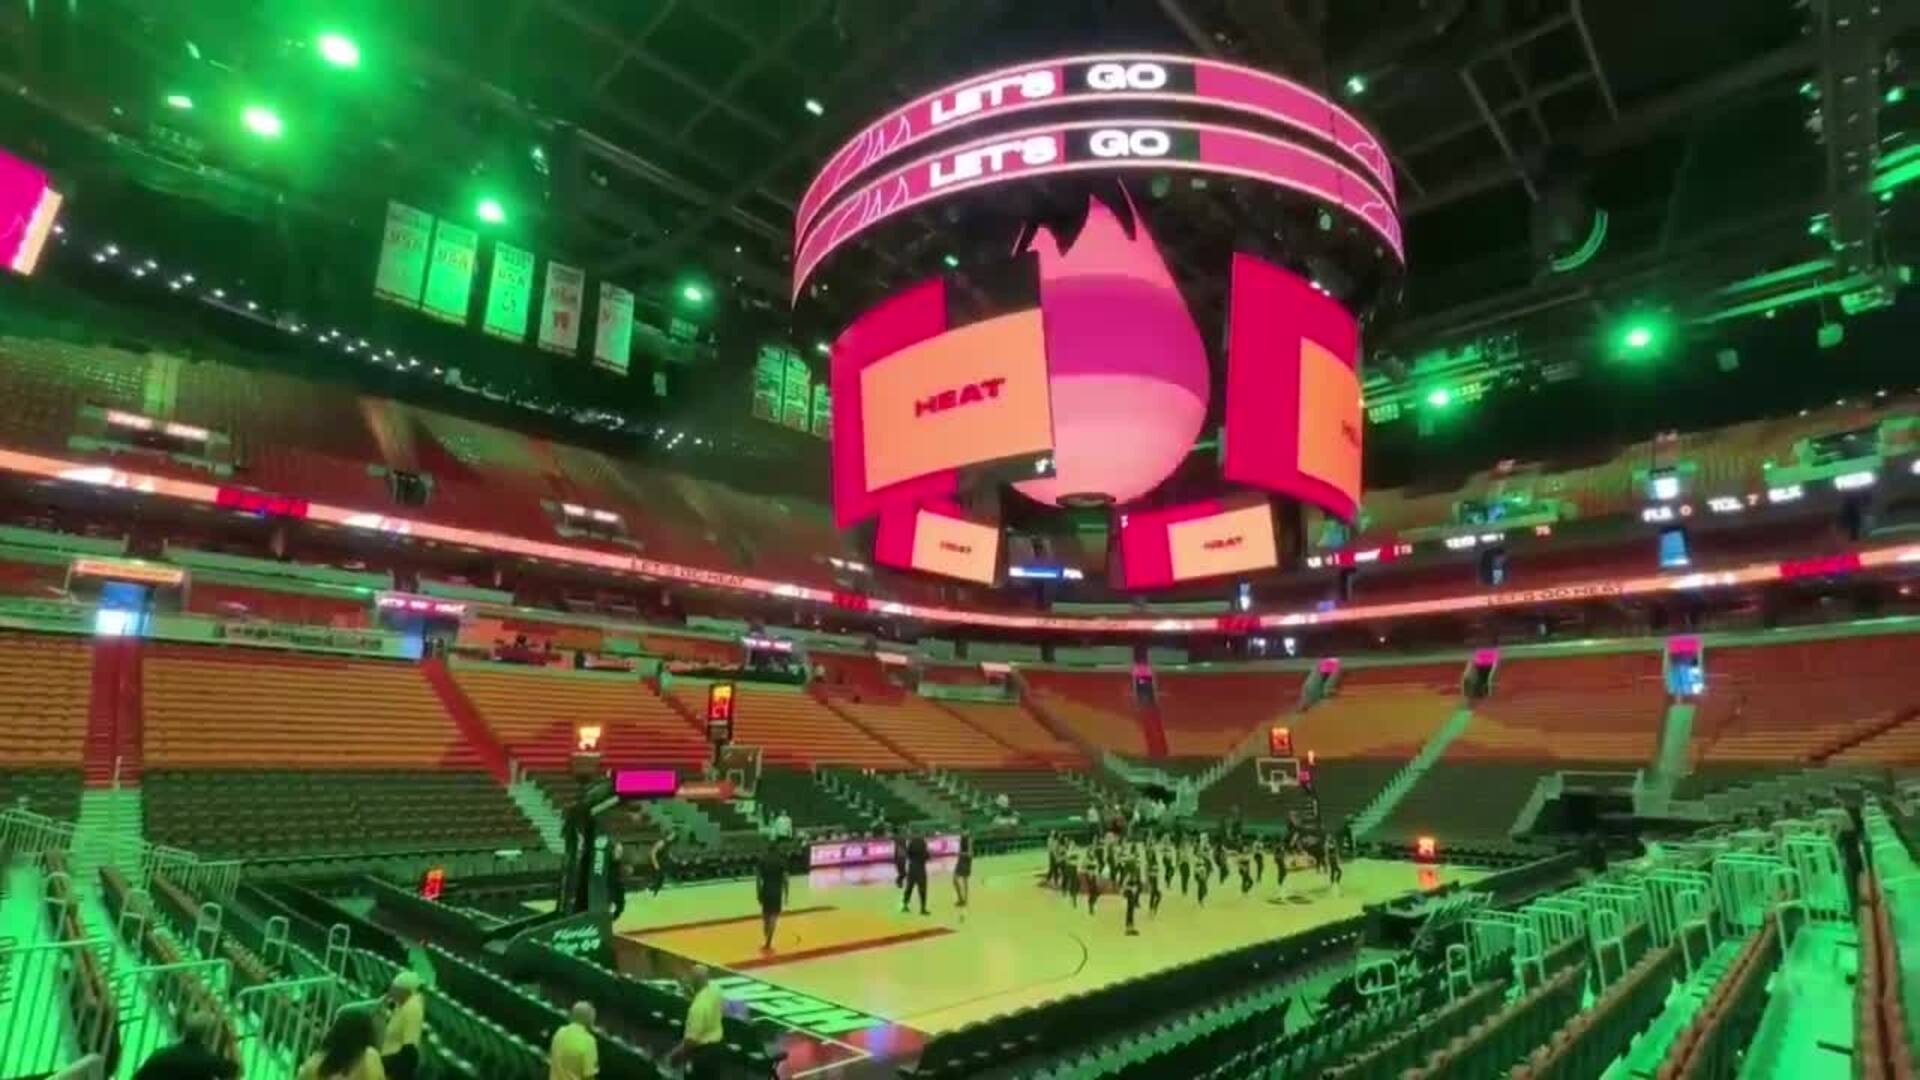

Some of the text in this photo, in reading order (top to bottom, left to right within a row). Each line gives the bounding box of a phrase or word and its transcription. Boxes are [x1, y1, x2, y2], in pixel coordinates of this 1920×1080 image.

[931, 63, 1168, 126] LET'S GO
[930, 129, 1171, 189] LET'S GO
[915, 378, 1006, 418] HEAT
